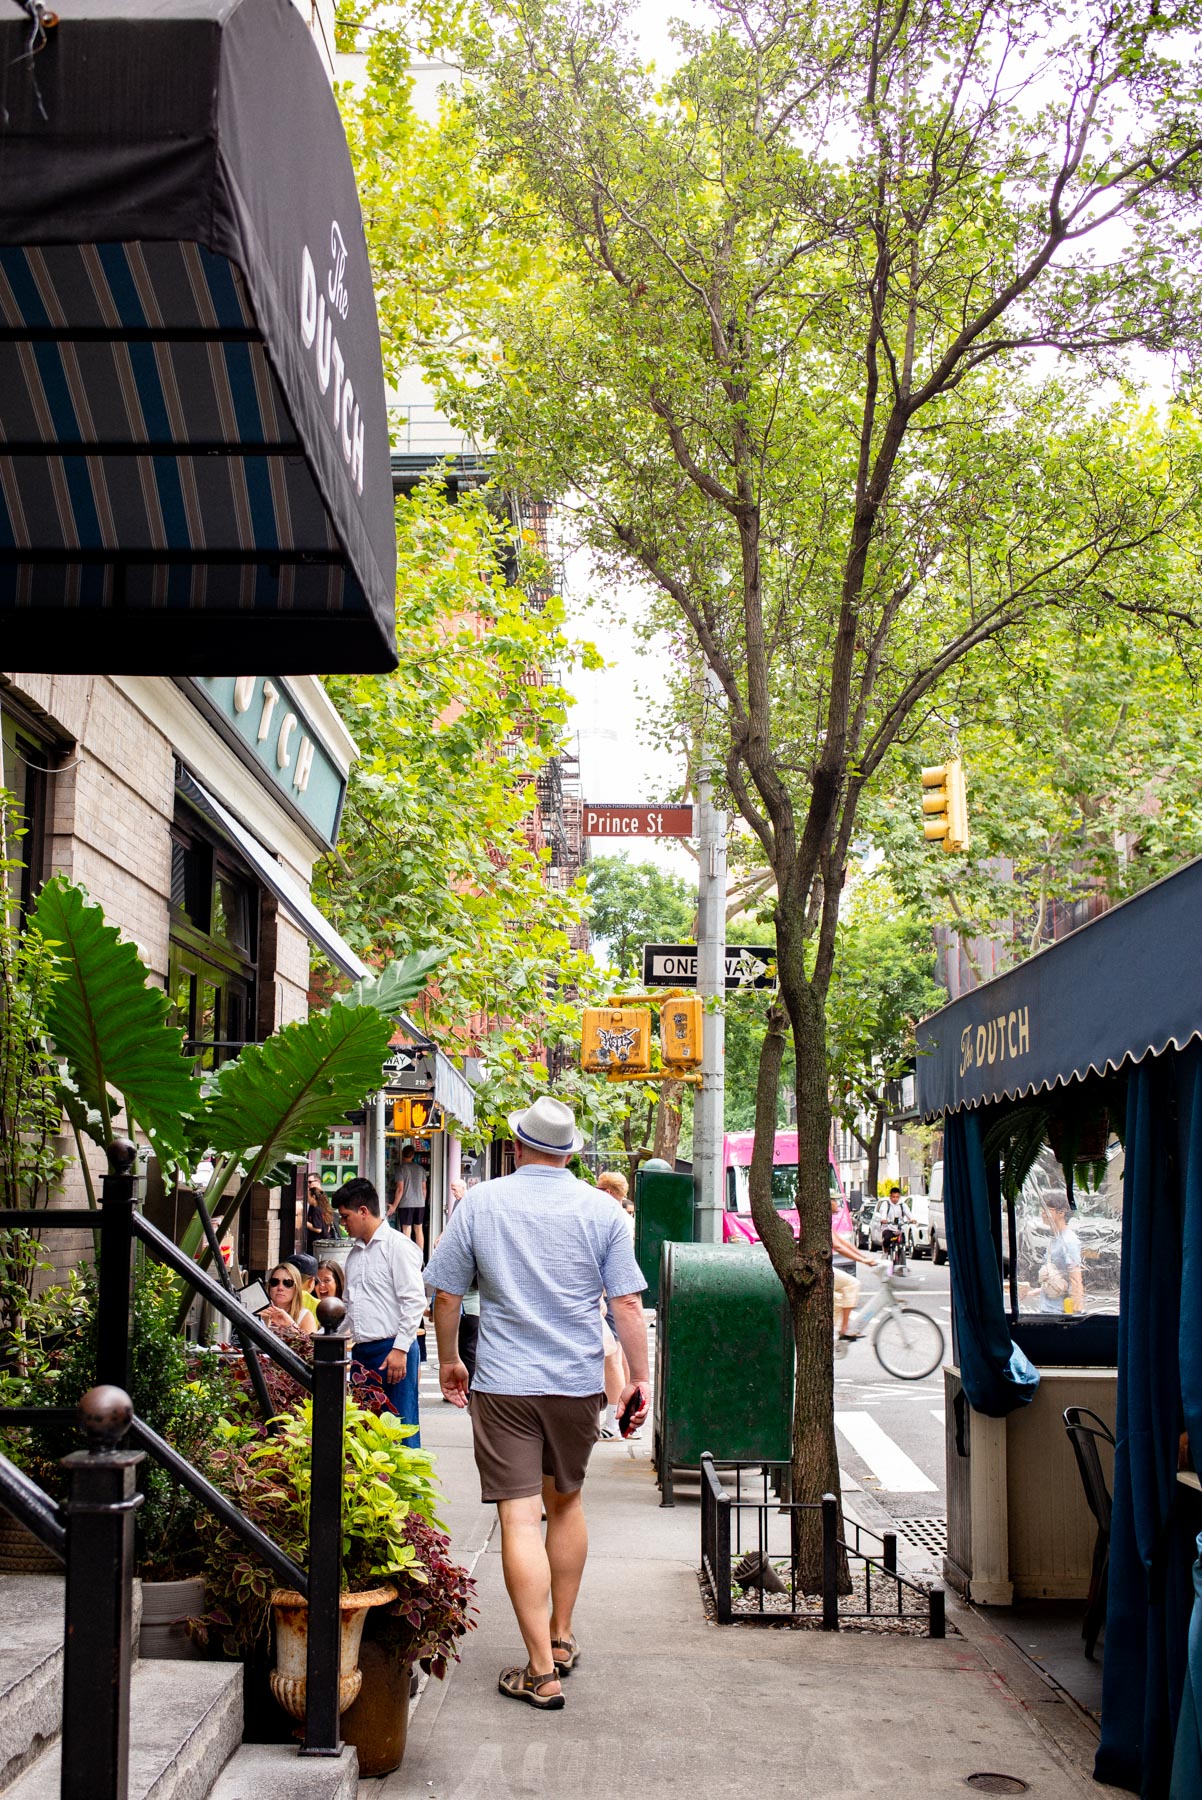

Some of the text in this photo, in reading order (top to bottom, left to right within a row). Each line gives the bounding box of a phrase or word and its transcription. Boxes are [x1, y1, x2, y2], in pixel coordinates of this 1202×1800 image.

[328, 220, 349, 320] The
[301, 244, 365, 496] DUTCH
[234, 676, 315, 792] UTCH
[587, 812, 664, 833] Prince St
[663, 958, 698, 975] ONE
[387, 1056, 406, 1065] WAY
[960, 1006, 1029, 1078] The DUTCH
